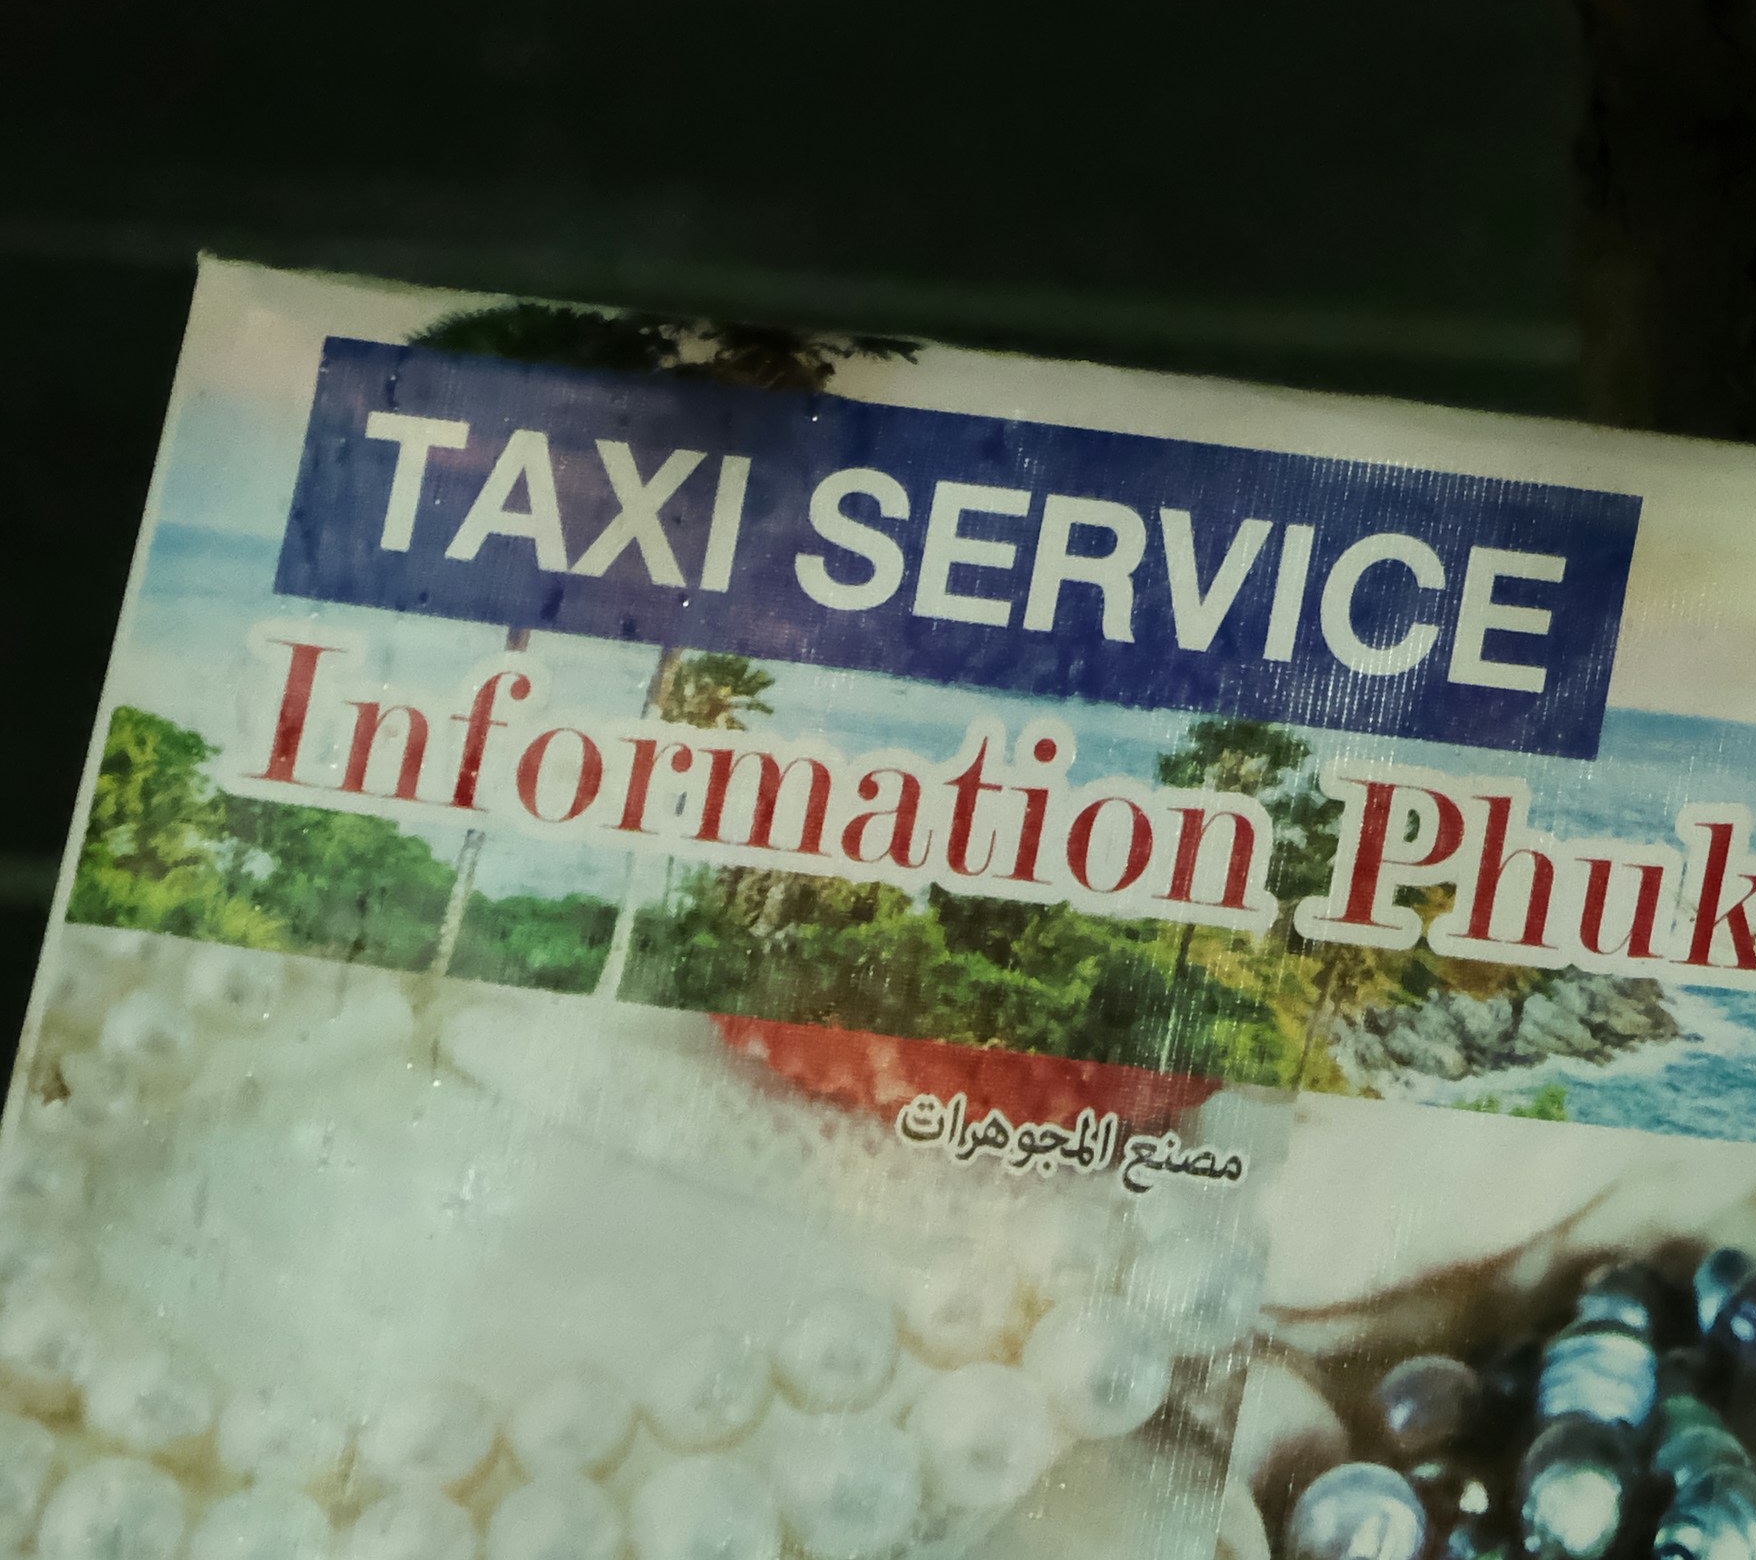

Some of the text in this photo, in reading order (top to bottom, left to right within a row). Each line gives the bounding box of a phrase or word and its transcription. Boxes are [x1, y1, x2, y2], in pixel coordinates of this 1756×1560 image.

[364, 410, 1568, 696] TAXI SERVICE
[256, 638, 1266, 914] Information
[900, 1096, 1244, 1193] مصنع المجوهرات
